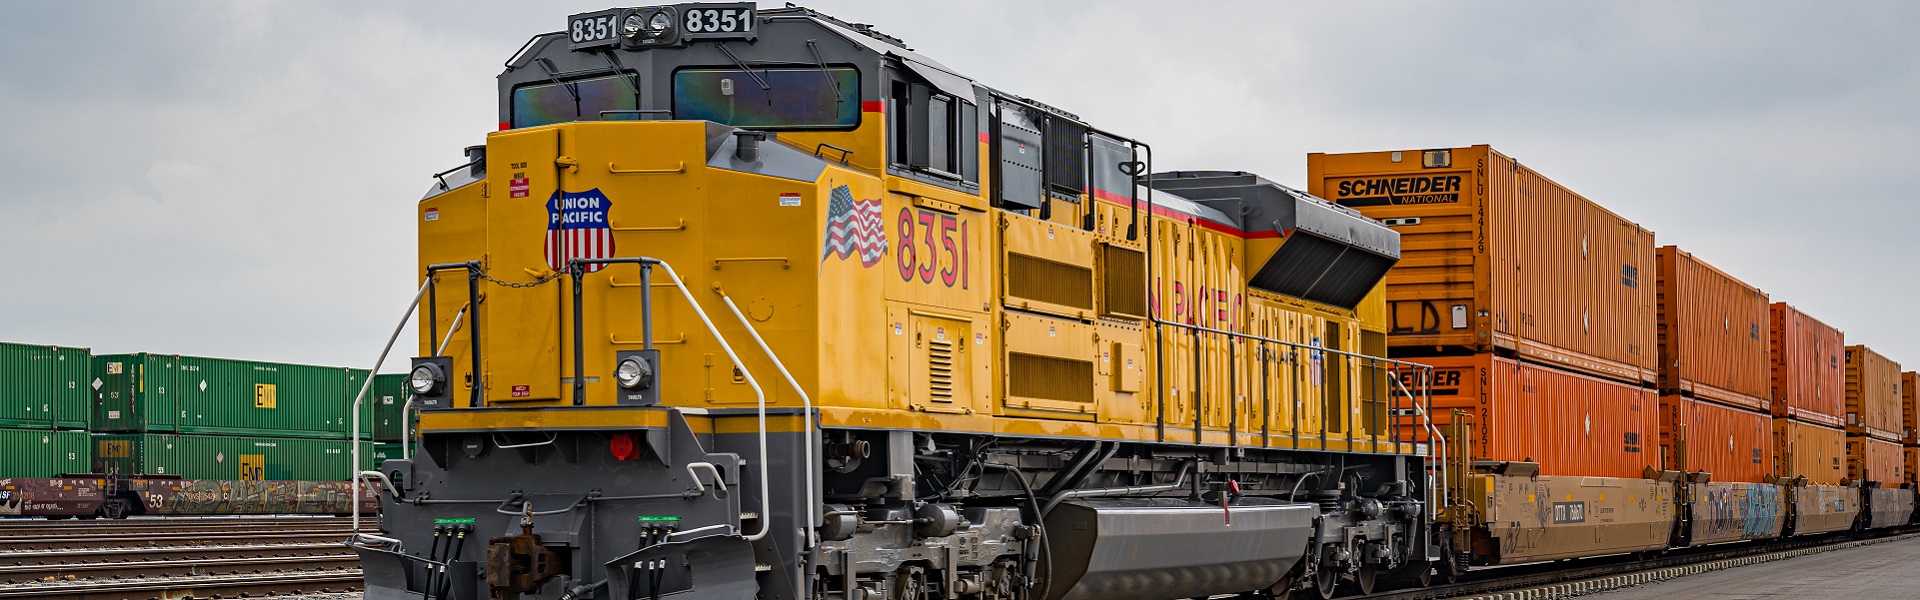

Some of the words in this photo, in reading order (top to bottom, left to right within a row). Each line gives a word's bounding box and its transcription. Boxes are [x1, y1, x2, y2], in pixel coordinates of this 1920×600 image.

[686, 9, 751, 33] 8351
[572, 15, 617, 43] 8351
[1337, 175, 1462, 197] SCHNEIDER
[554, 197, 600, 210] UNION
[1401, 194, 1455, 205] NATIONAL
[552, 211, 603, 224] PACIFIC
[897, 206, 968, 290] 8351
[68, 452, 76, 460] 53
[157, 466, 165, 474] 53
[149, 494, 163, 508] 53
